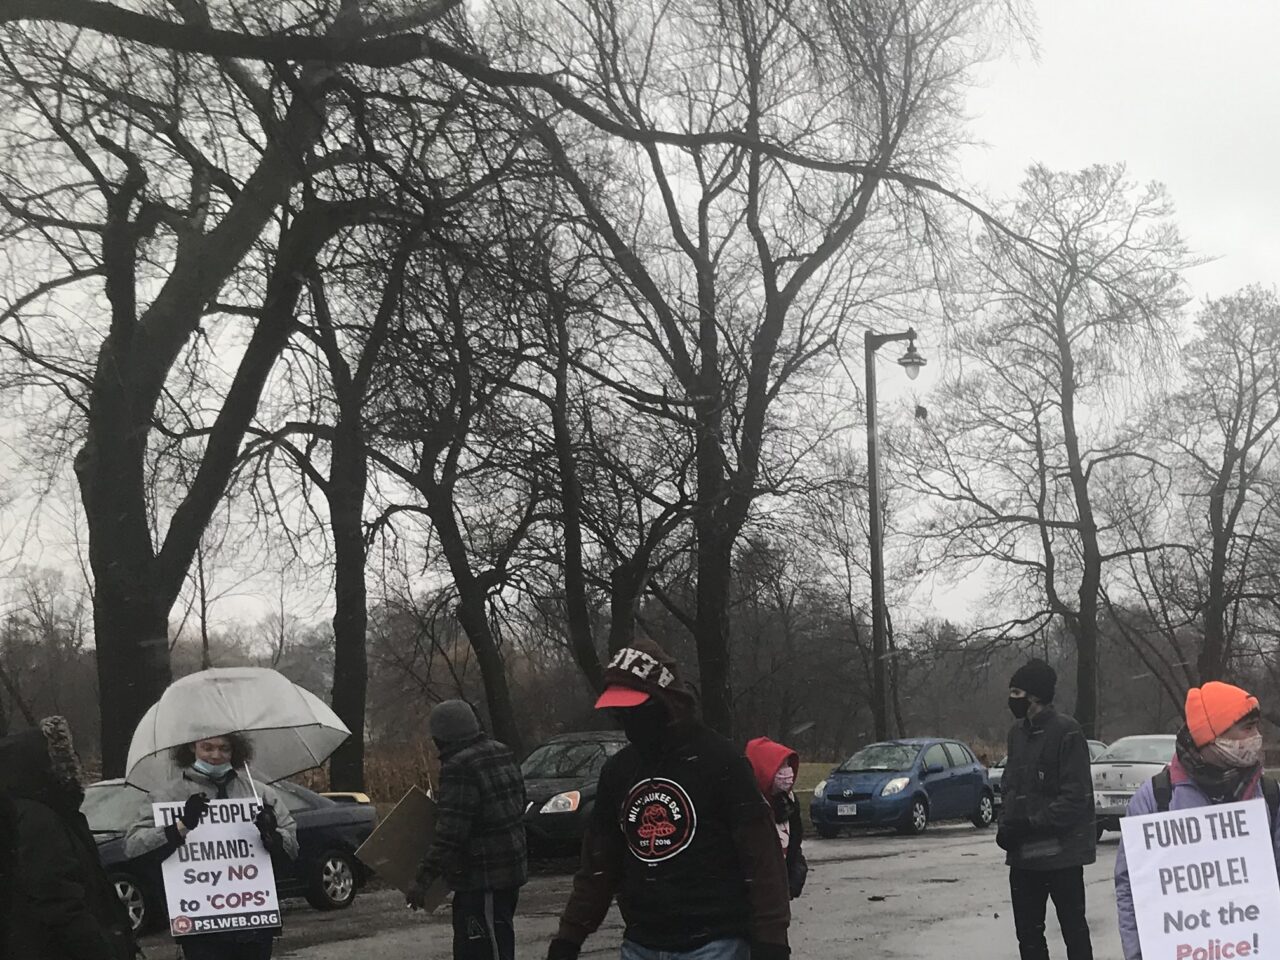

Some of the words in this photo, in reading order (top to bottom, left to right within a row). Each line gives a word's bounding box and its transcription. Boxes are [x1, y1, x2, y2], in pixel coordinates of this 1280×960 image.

[159, 807, 184, 828] TH
[199, 803, 258, 825] PEOPLE
[668, 800, 682, 821] DSA
[1142, 816, 1202, 850] FUND
[1205, 809, 1250, 840] THE
[178, 839, 255, 862] DEMAND:
[184, 868, 223, 886] Say
[228, 864, 259, 881] NO
[1158, 856, 1249, 895] PEOPLE!
[179, 898, 200, 912] to
[206, 890, 270, 910] 'COPS'
[194, 913, 278, 931] PSLWEB.ORG
[1163, 909, 1211, 934] Not
[1218, 902, 1260, 926] the
